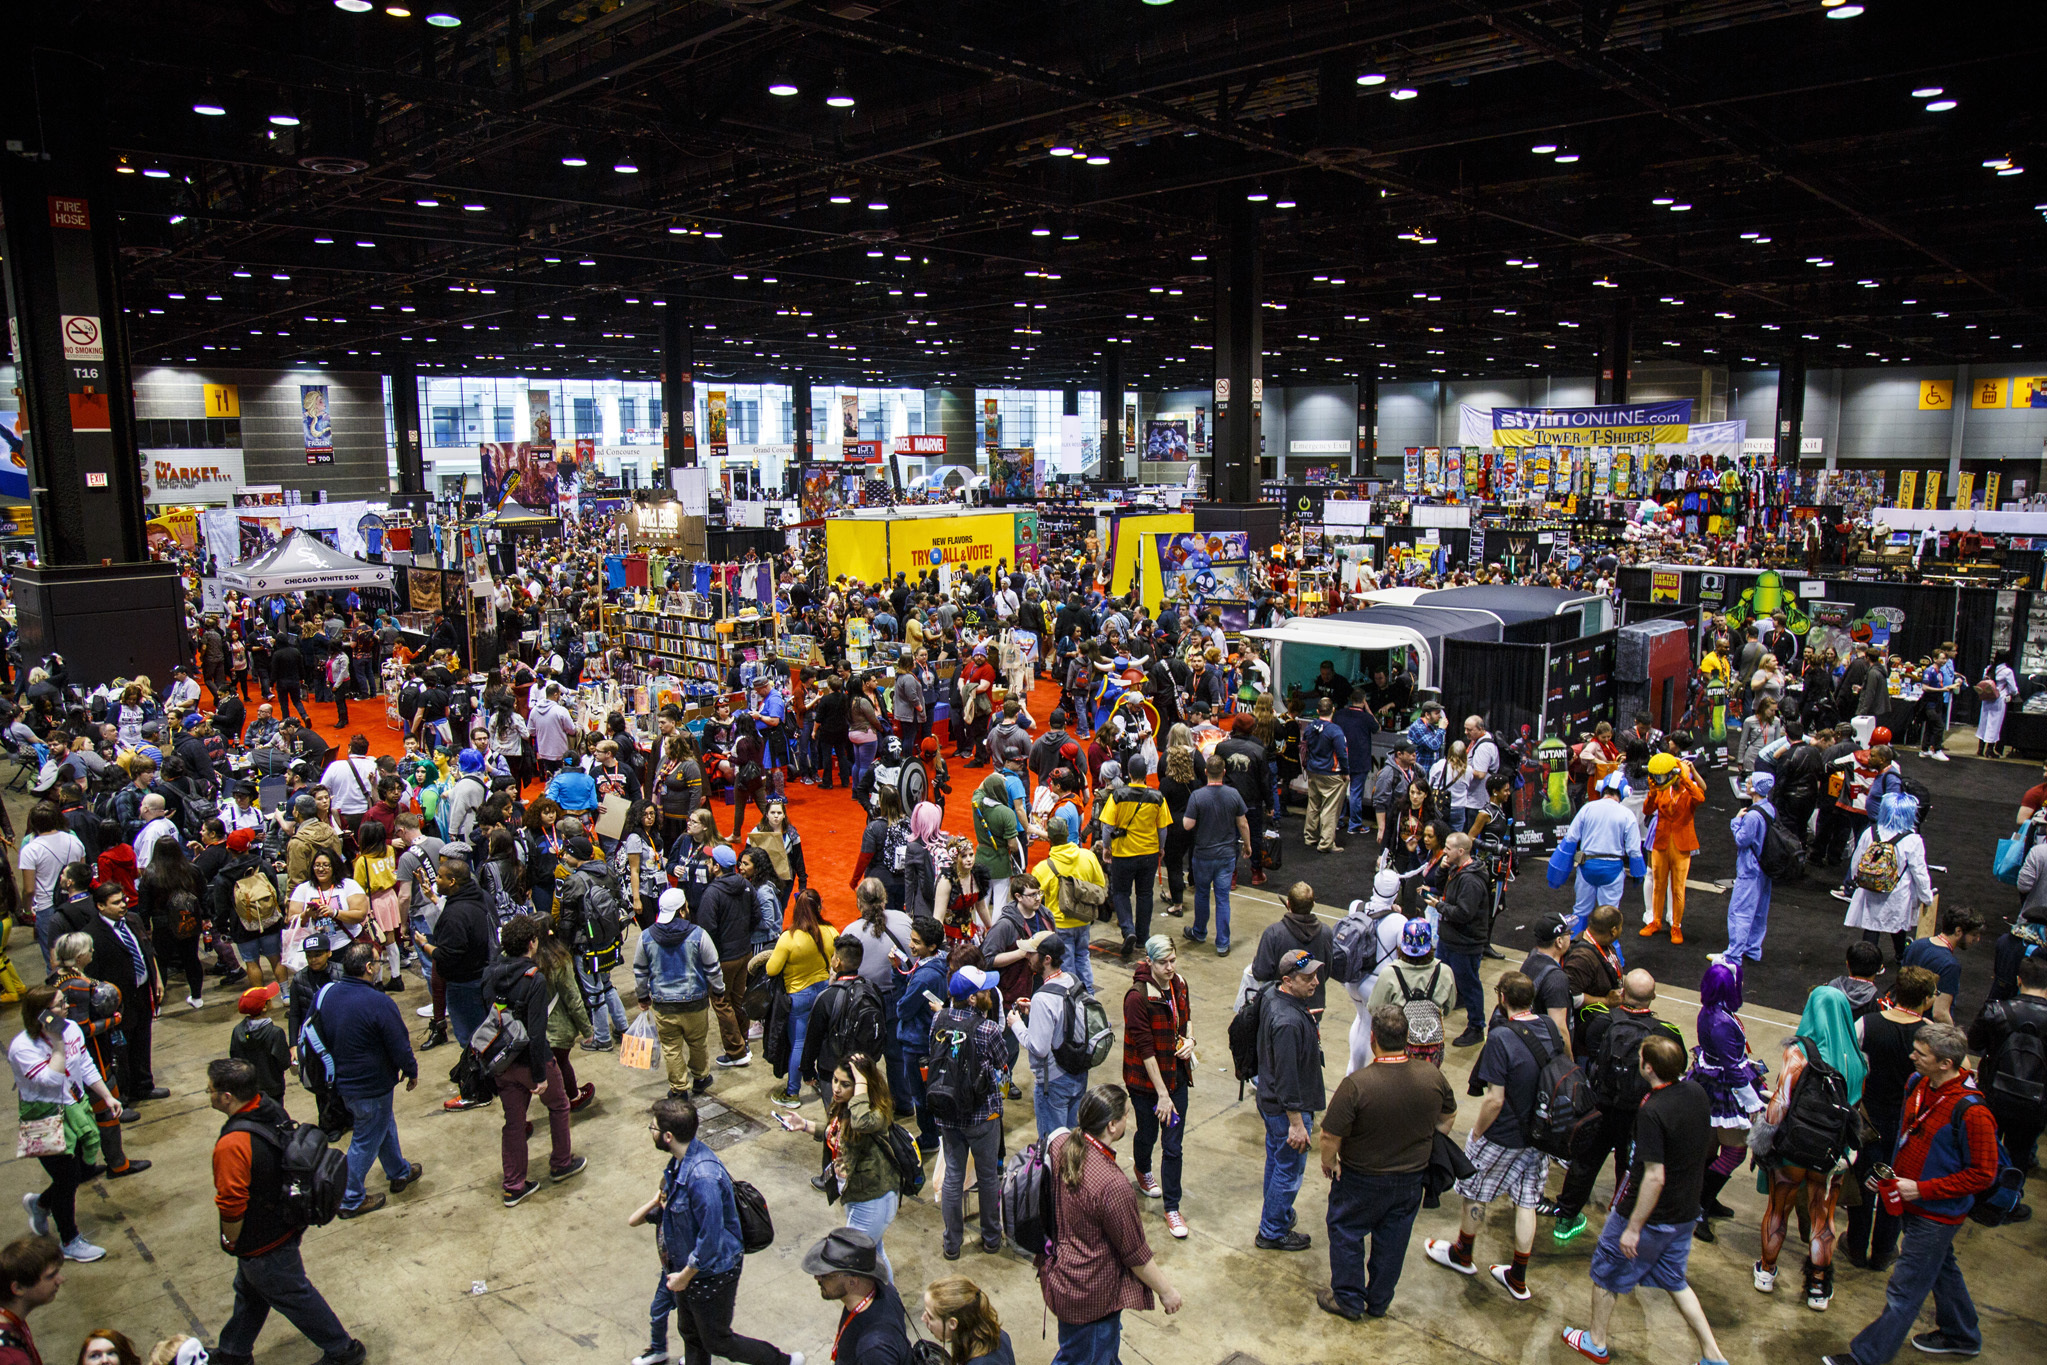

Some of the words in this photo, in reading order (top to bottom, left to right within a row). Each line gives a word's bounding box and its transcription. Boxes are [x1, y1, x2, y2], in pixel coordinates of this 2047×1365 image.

[56, 201, 82, 213] FIRE
[55, 213, 86, 226] HOSE
[75, 347, 104, 355] SMOKING
[73, 368, 99, 379] T16
[1501, 410, 1569, 431] stylin
[1572, 409, 1681, 425] ONLINE.com
[753, 446, 771, 454] Grand
[895, 438, 911, 452] RVEL
[914, 438, 944, 452] MARVEL
[1293, 442, 1331, 450] Emergency
[1744, 441, 1776, 450] merge
[90, 474, 105, 483] EXIT
[168, 515, 193, 523] MAD
[932, 537, 946, 546] NEW
[948, 535, 973, 545] FLAVORS
[911, 550, 930, 566] TRY
[942, 547, 960, 563] ALL
[961, 549, 967, 561] &
[966, 544, 993, 560] VOTE!
[284, 577, 318, 585] CHICAGO
[1654, 573, 1678, 581] BATTLE
[1539, 749, 1567, 759] MUTANT
